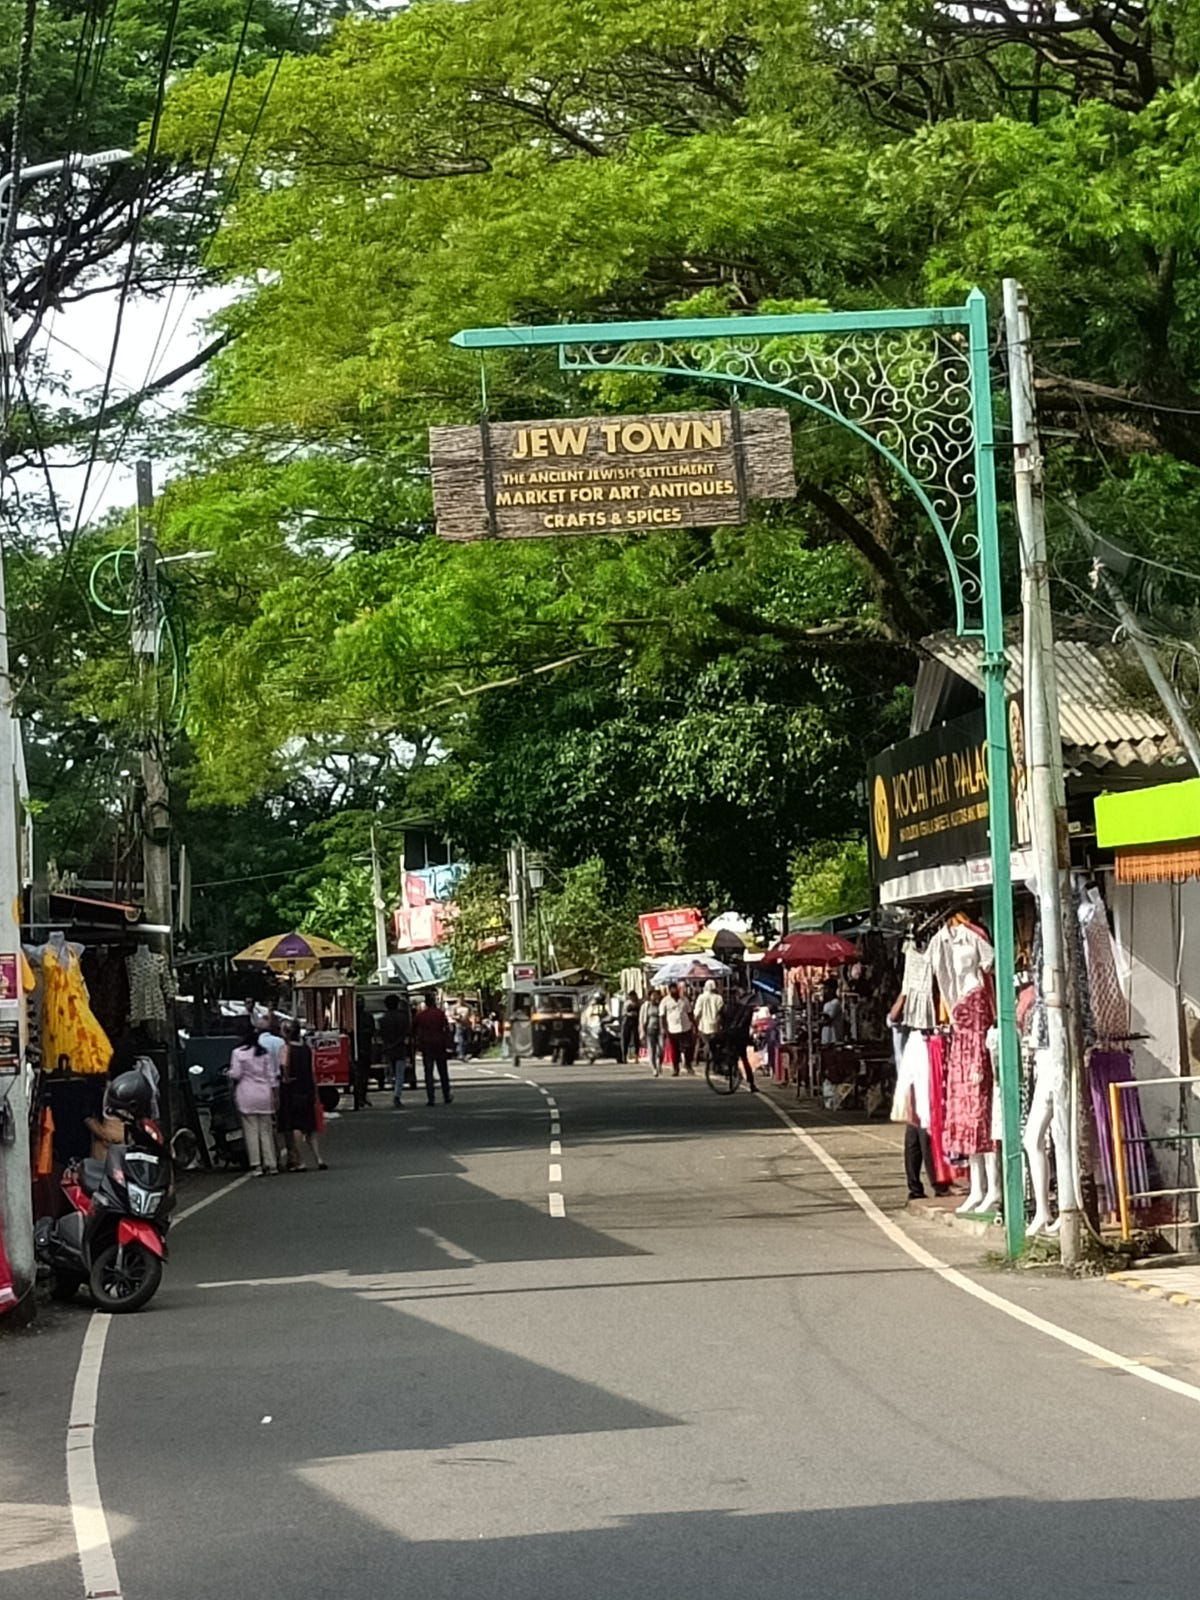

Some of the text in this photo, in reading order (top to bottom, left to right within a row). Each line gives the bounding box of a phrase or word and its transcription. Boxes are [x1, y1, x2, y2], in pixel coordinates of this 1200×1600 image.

[512, 420, 722, 459] JEW TOWN
[502, 463, 715, 485] THE ANCIENT JEWISH SETTLEMENT
[495, 488, 566, 506] MARKET
[569, 486, 604, 502] FOR
[543, 508, 682, 529] CRAFTS & SPICES
[892, 766, 929, 818] KOCHI
[930, 755, 950, 807] ART
